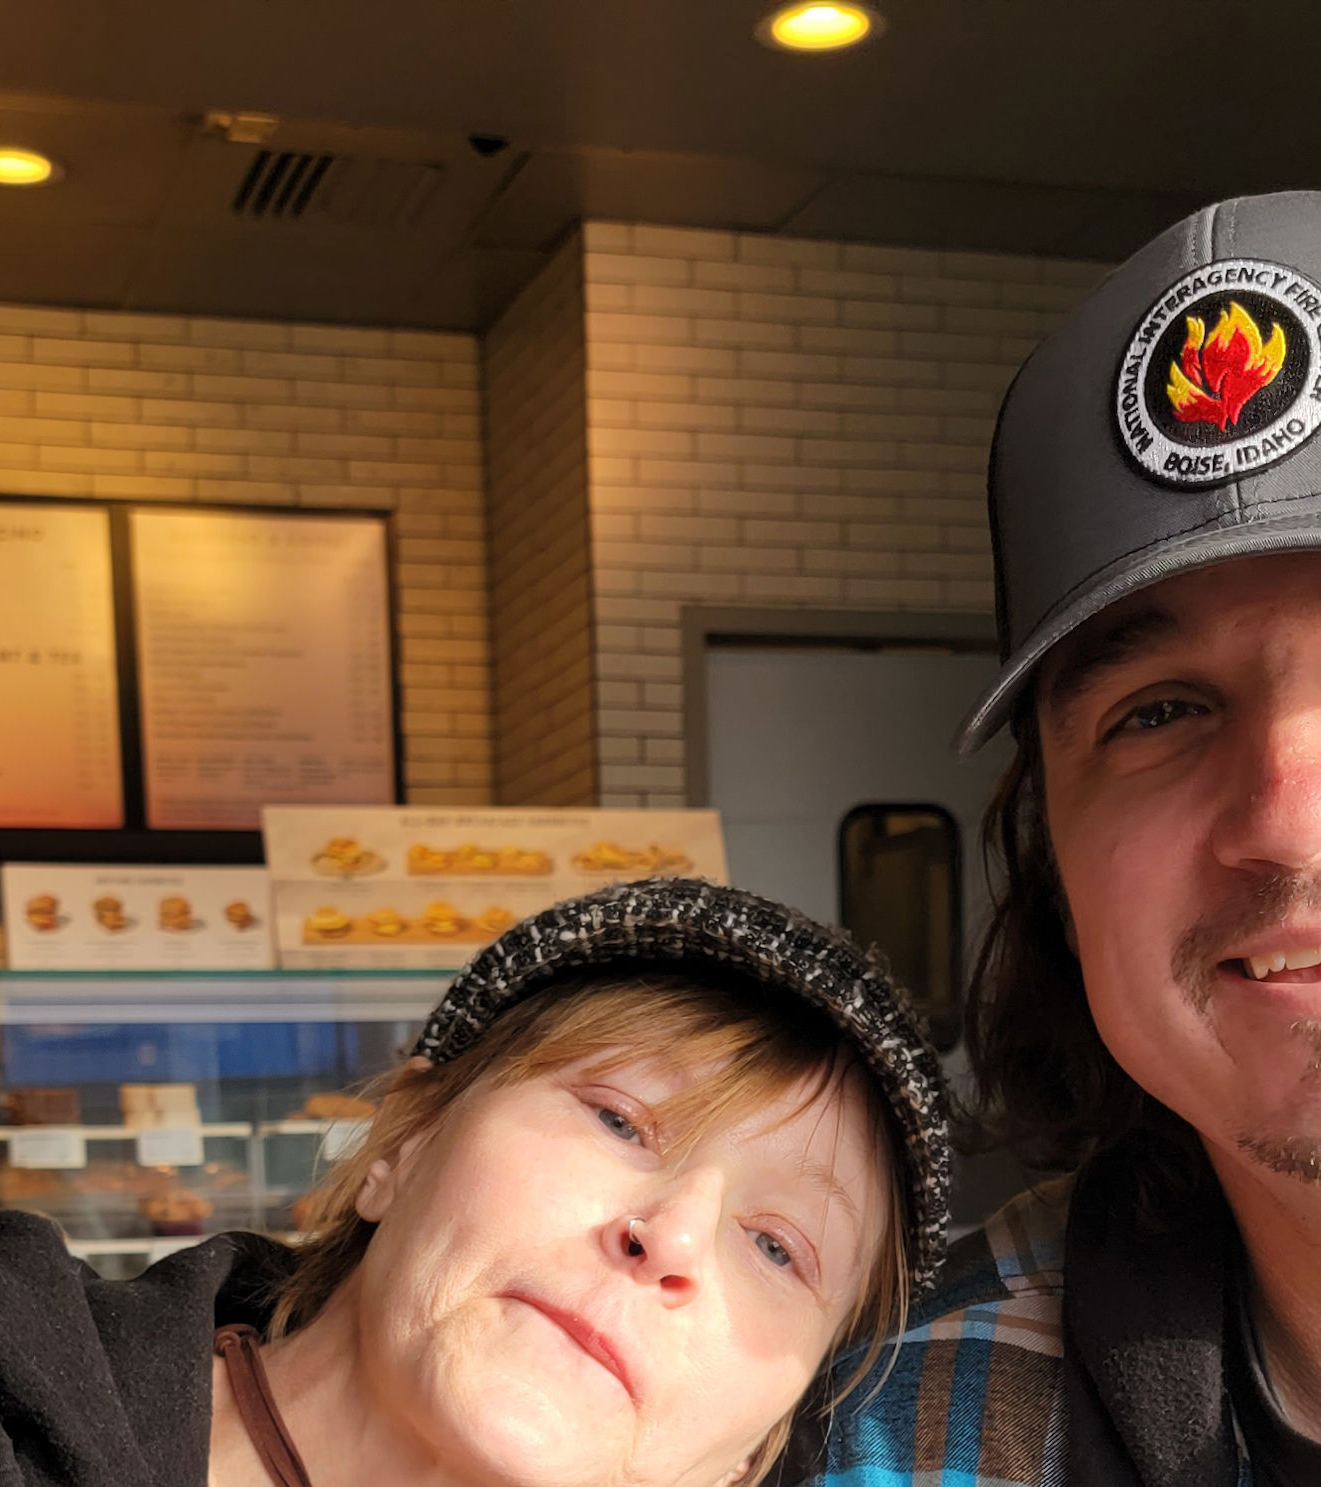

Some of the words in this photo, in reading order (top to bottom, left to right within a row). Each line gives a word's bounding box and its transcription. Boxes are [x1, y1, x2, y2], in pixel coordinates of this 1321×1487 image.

[1121, 343, 1154, 455] NATIONAL
[1138, 267, 1286, 348] INTERAGENCY
[1163, 452, 1231, 475] BOISE,
[1236, 418, 1306, 466] IDAHO
